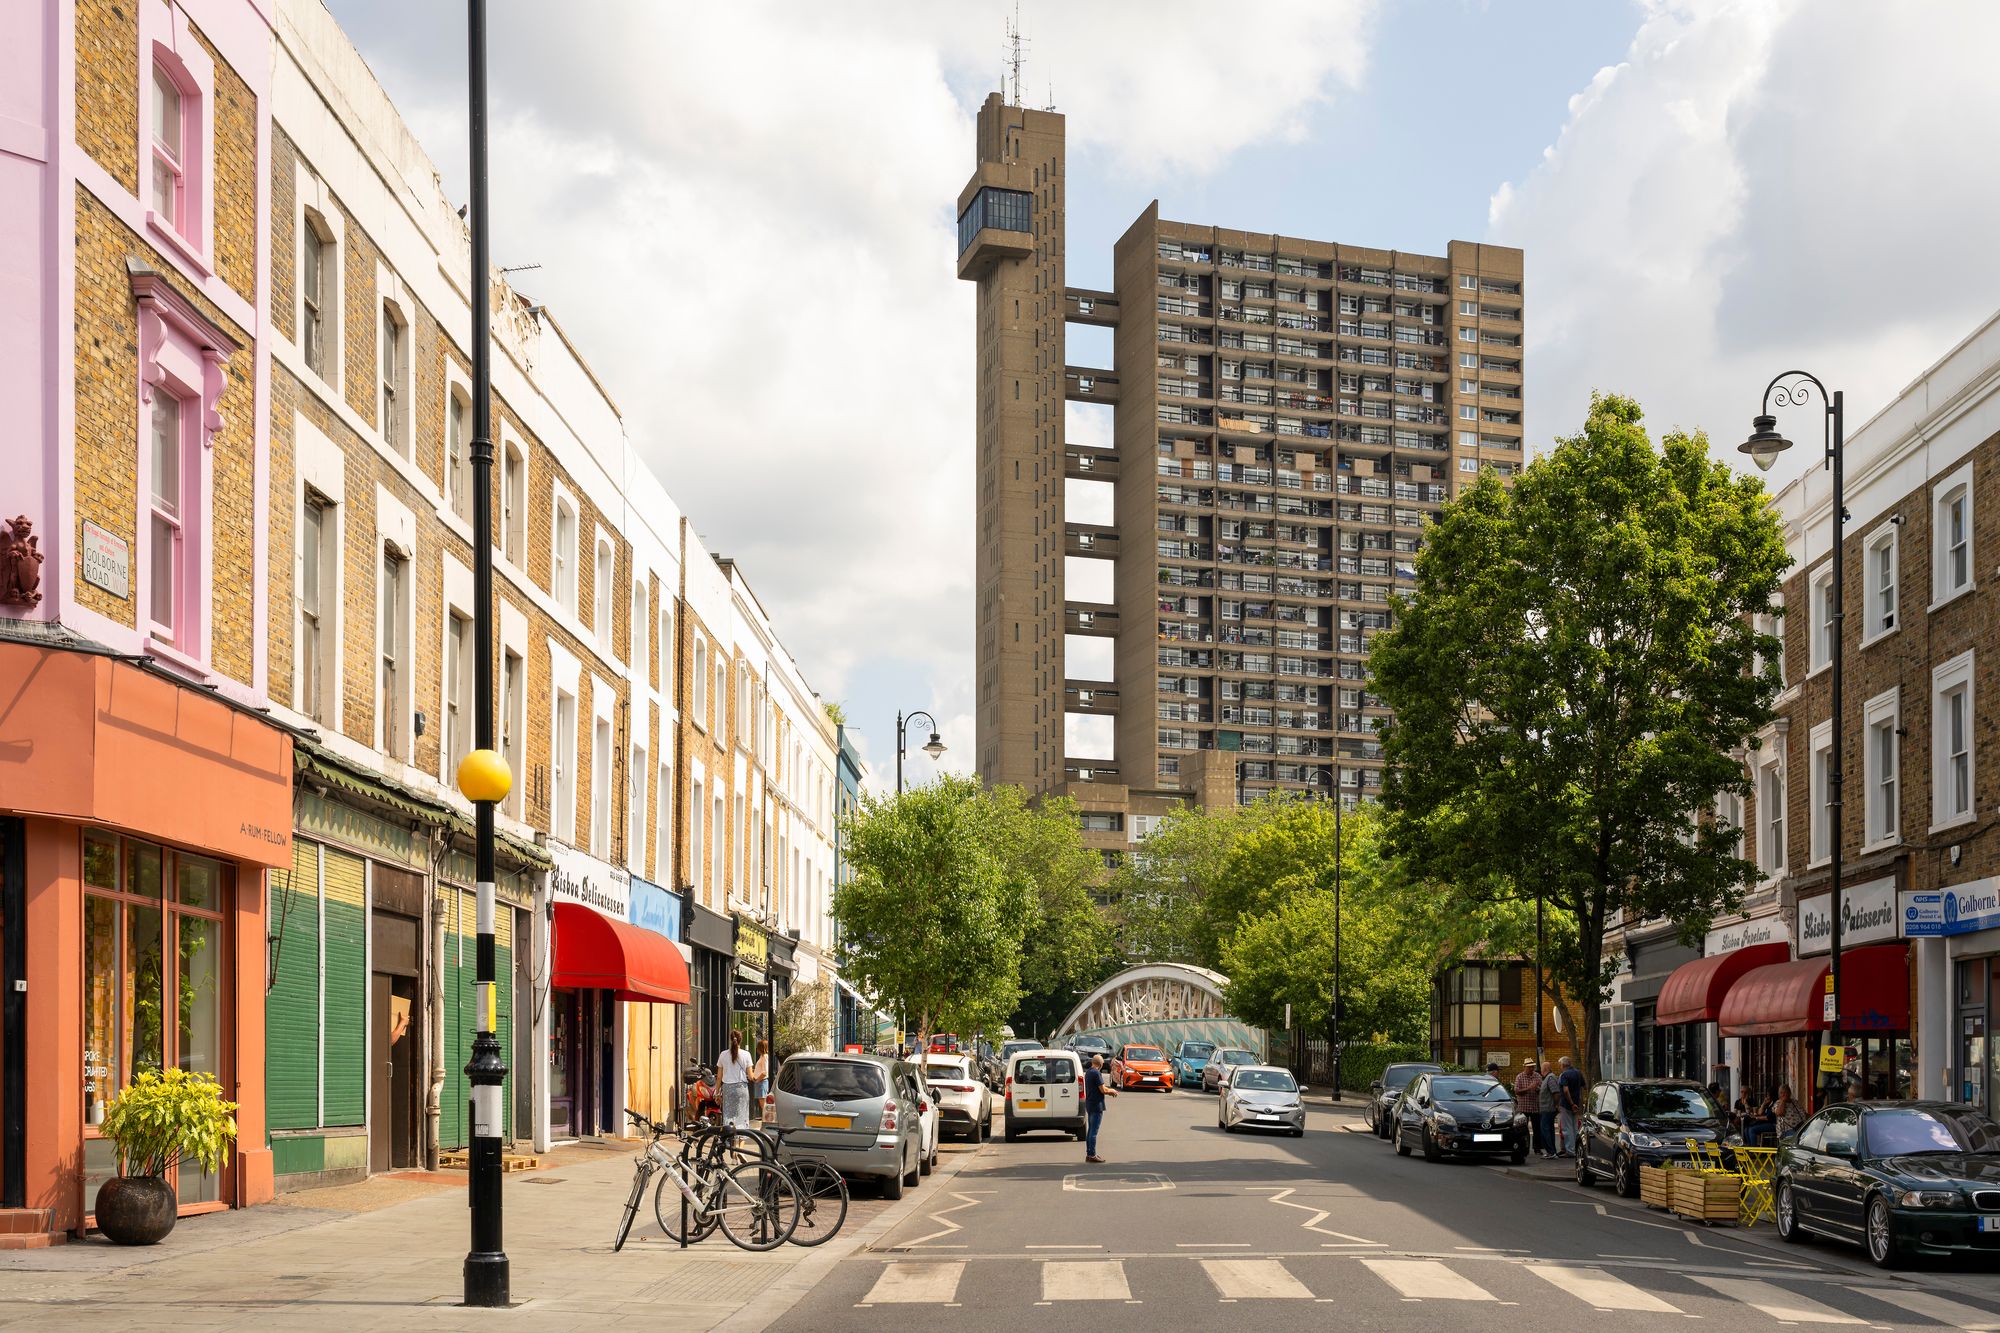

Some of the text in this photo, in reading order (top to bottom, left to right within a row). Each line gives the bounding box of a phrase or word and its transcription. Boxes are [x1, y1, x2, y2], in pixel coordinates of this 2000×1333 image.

[86, 547, 127, 579] GOLBORNE
[581, 875, 625, 916] Delicatessen
[1959, 894, 1996, 915] Golborne
[1803, 897, 1893, 939] Lisbo Patisserie
